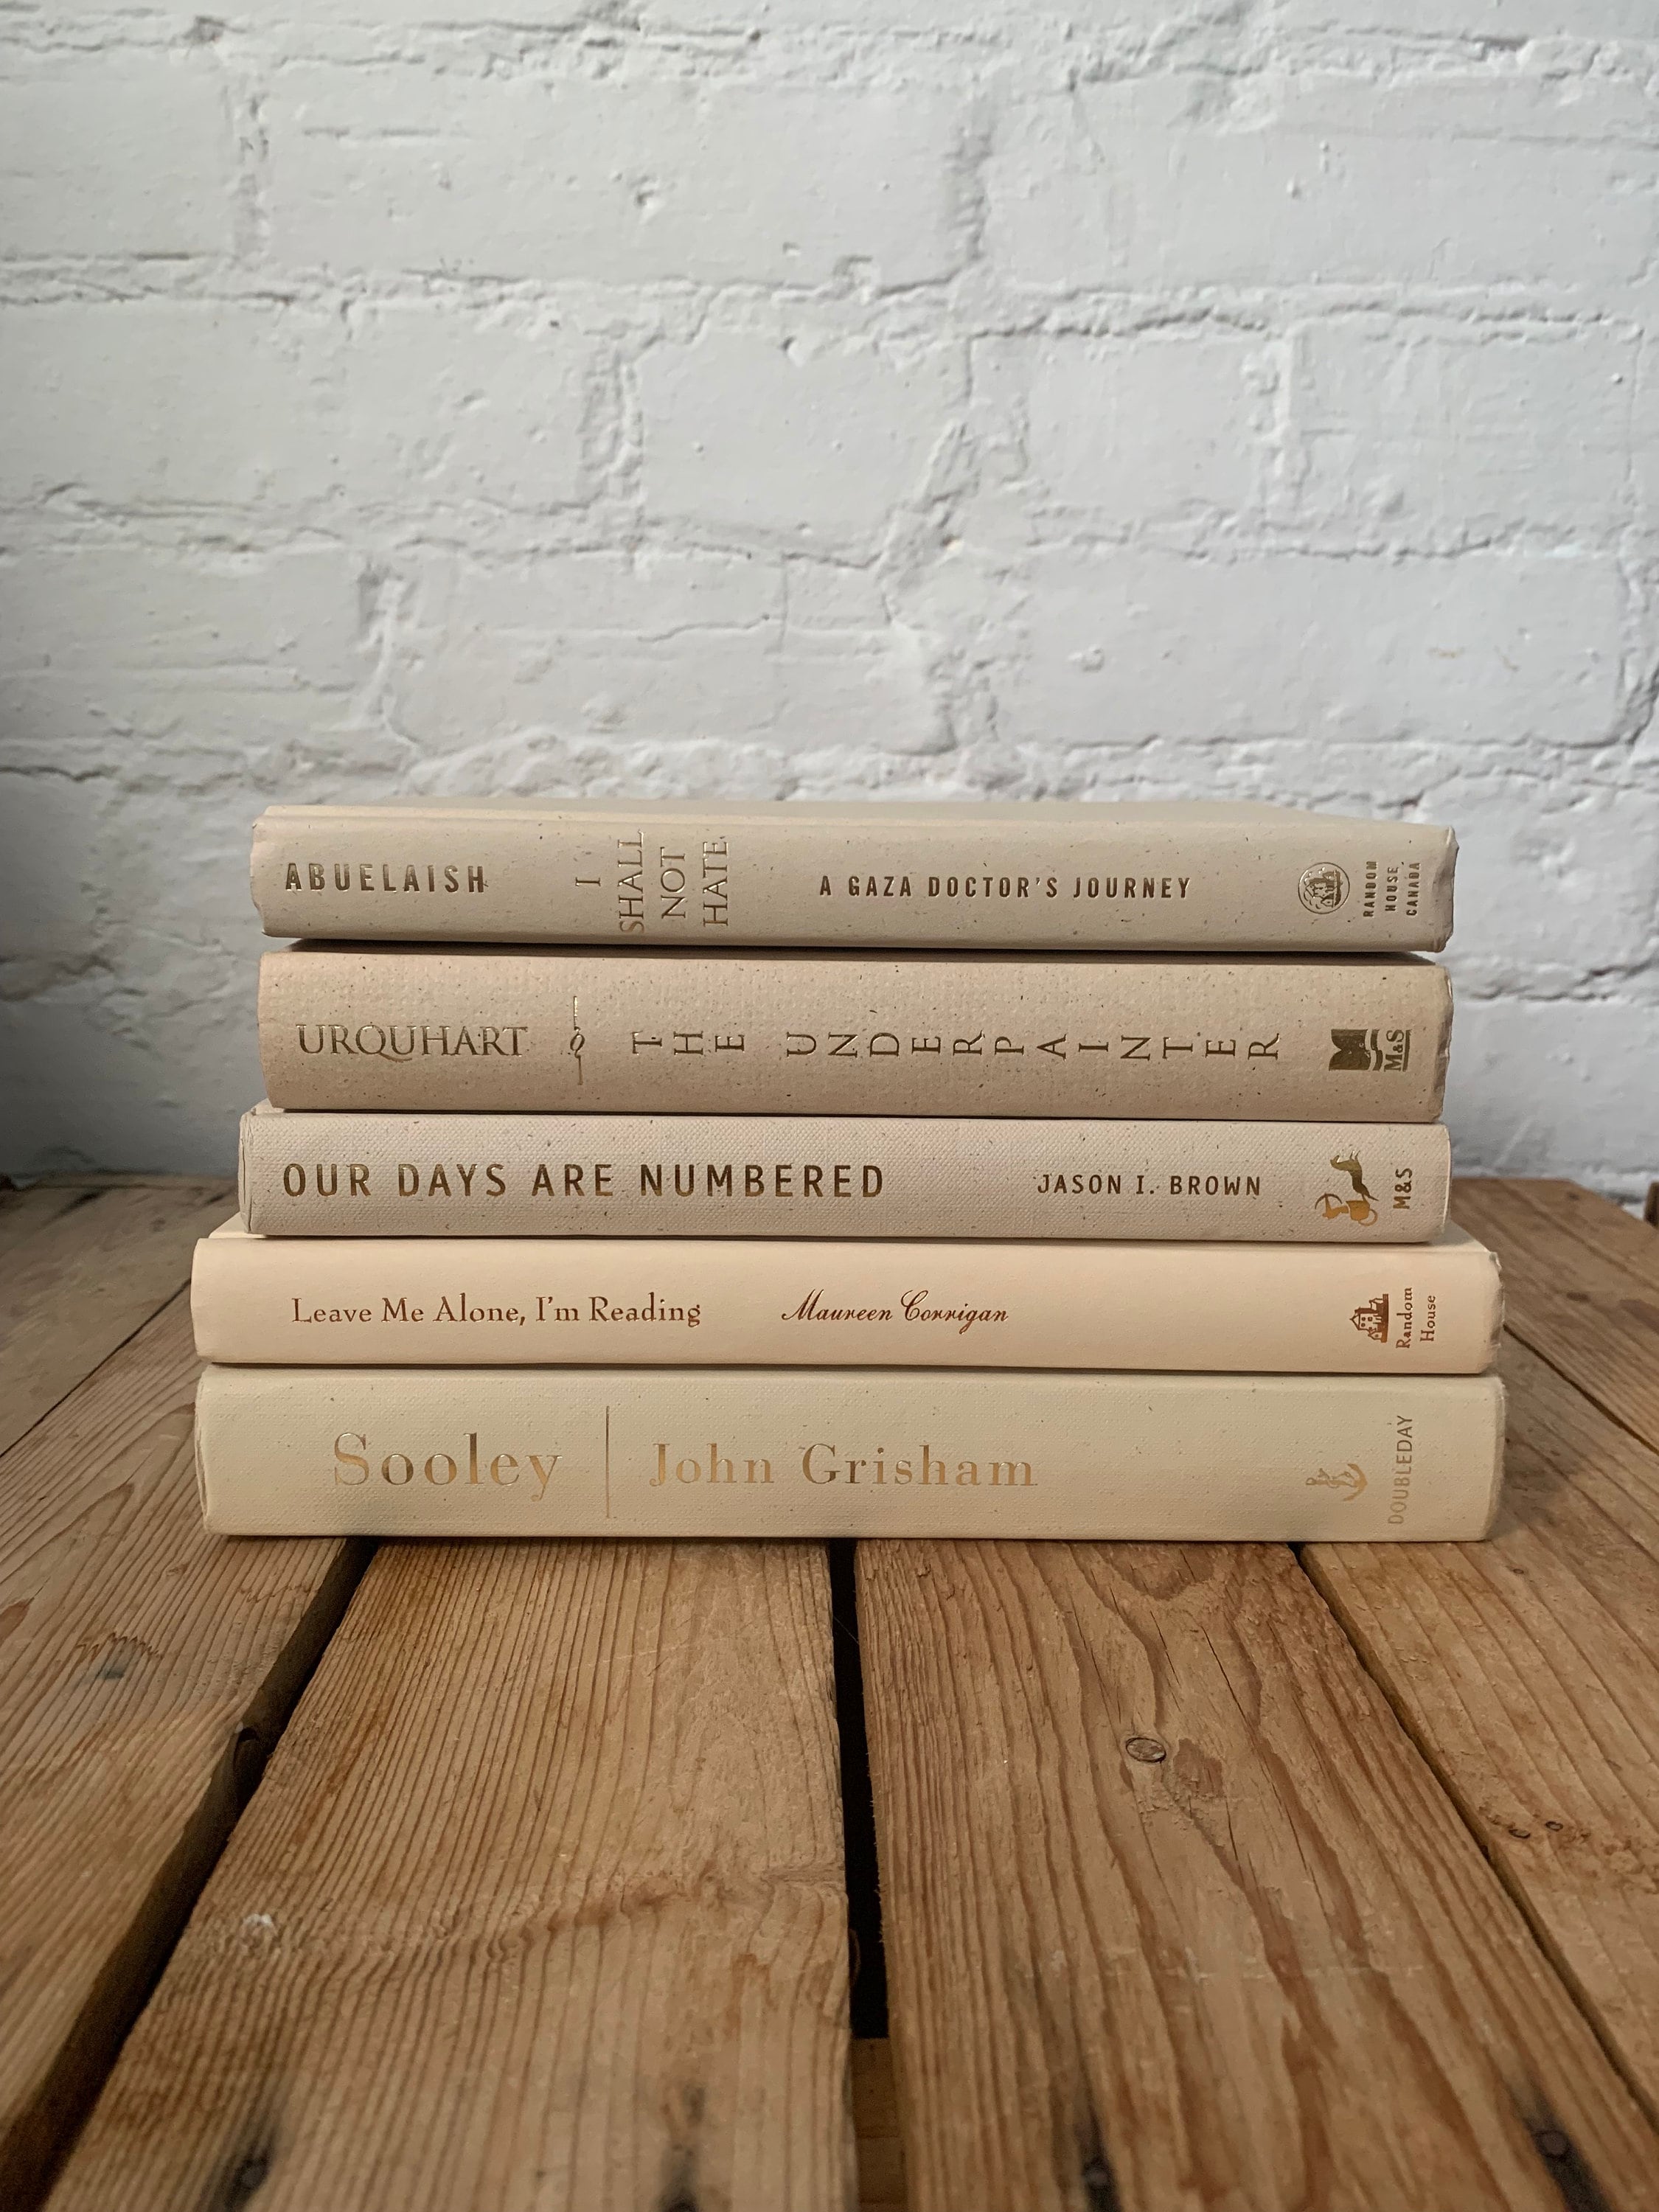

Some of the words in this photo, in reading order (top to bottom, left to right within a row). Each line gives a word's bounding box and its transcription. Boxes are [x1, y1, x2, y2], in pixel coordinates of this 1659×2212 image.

[285, 862, 485, 893] ABUELAISH
[575, 877, 601, 886] I
[619, 830, 646, 934] SHALL
[661, 846, 686, 919] NOT
[703, 840, 728, 928] HATE
[819, 875, 832, 897] A
[848, 875, 912, 897] GAZA
[928, 876, 1059, 898] DOCTOR'S
[1073, 877, 1191, 899] JOURNEY
[1363, 860, 1378, 918] RANDOM
[1384, 866, 1399, 911] HOUSE
[1406, 861, 1421, 917] CANADA
[296, 1024, 529, 1062] URQUHART
[632, 1030, 745, 1057] THE
[786, 1029, 1280, 1060] UNDERPAINTER
[1383, 1029, 1405, 1072] M&S
[282, 1163, 372, 1197] OUR
[397, 1163, 507, 1197] DAYS
[531, 1163, 613, 1197] ARE
[640, 1164, 884, 1198] NUMBERED
[1037, 1175, 1121, 1195] JASON
[1169, 1175, 1261, 1196] BROWN
[1393, 1168, 1413, 1210] M&S
[291, 1297, 372, 1324] Leave
[380, 1296, 425, 1324] Me
[432, 1293, 526, 1326] Alone,
[535, 1295, 579, 1323] I'm
[588, 1292, 701, 1328] Reading
[781, 1288, 893, 1322] Maureen
[900, 1290, 1009, 1335] Corrigan
[1396, 1287, 1413, 1349] Random
[1420, 1294, 1436, 1342] House
[333, 1432, 563, 1501] Sooley
[649, 1442, 774, 1487] John
[801, 1442, 1038, 1487] Grisham
[1387, 1415, 1414, 1524] DOUBLEDAY
